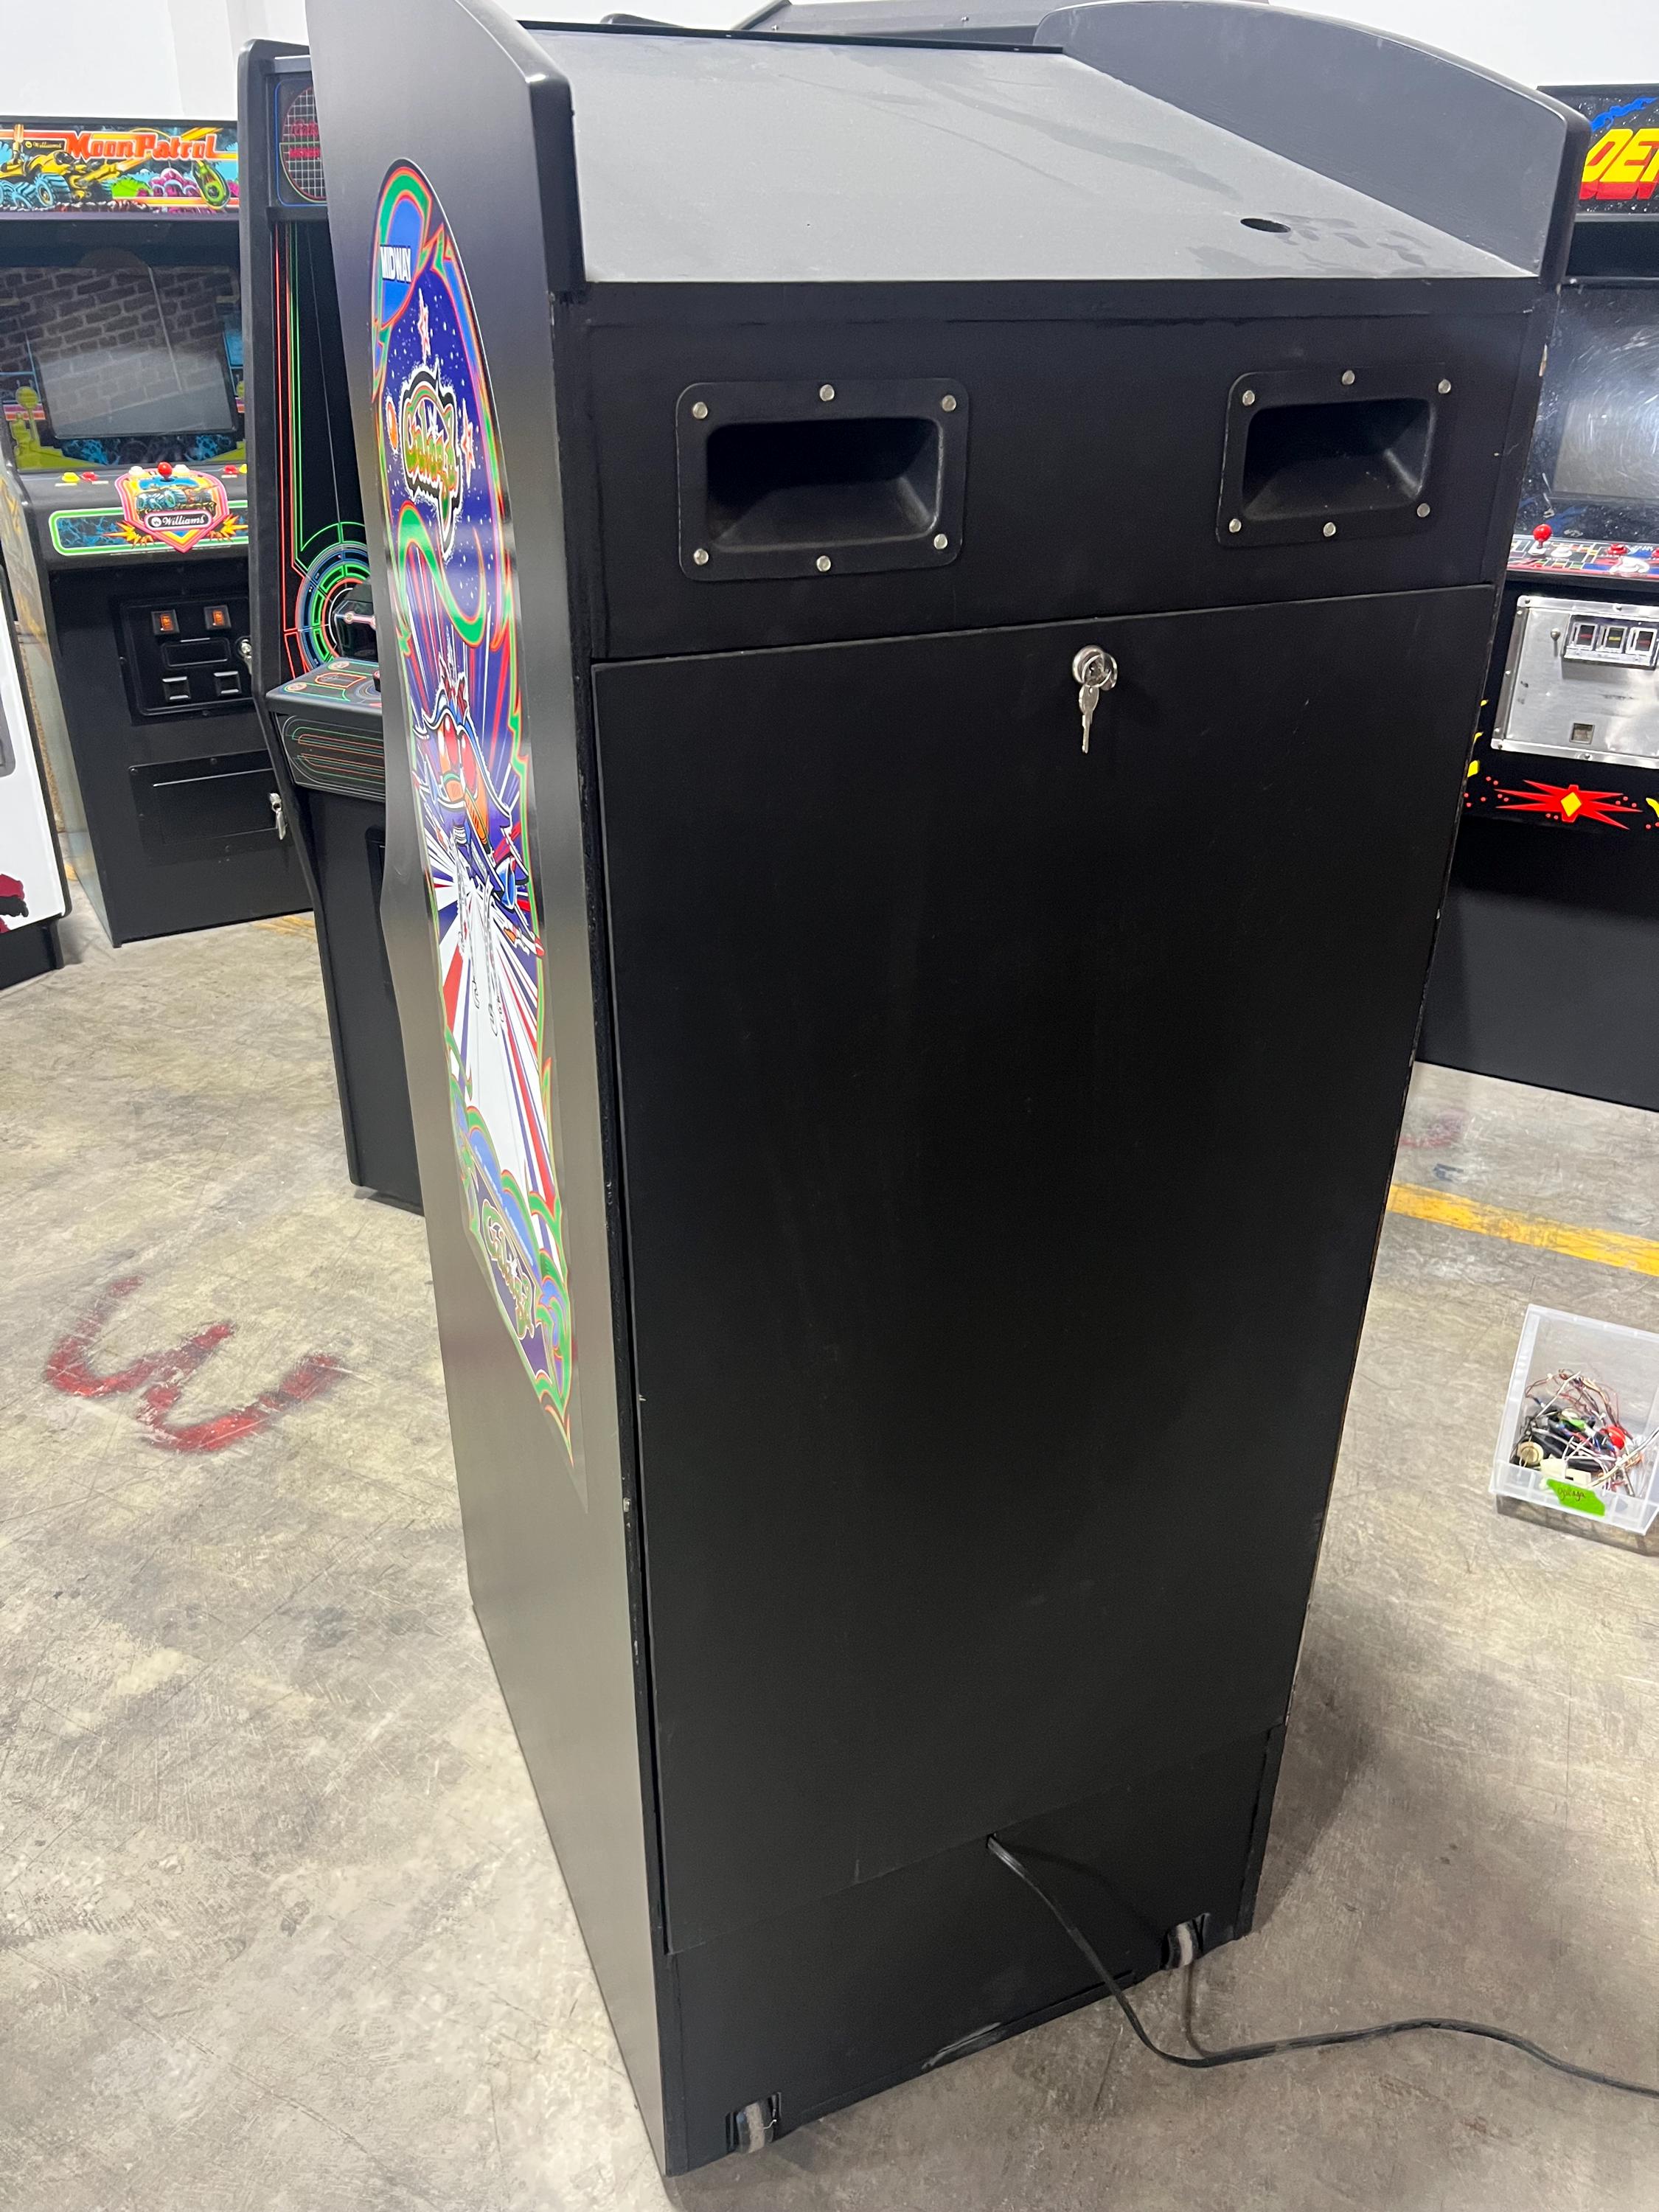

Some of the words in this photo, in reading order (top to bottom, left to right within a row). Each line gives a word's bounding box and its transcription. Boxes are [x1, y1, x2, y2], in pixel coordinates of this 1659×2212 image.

[66, 132, 135, 161] Moon
[1579, 128, 1659, 200] DE
[380, 246, 411, 283] MIDWAY
[162, 515, 206, 526] Williams
